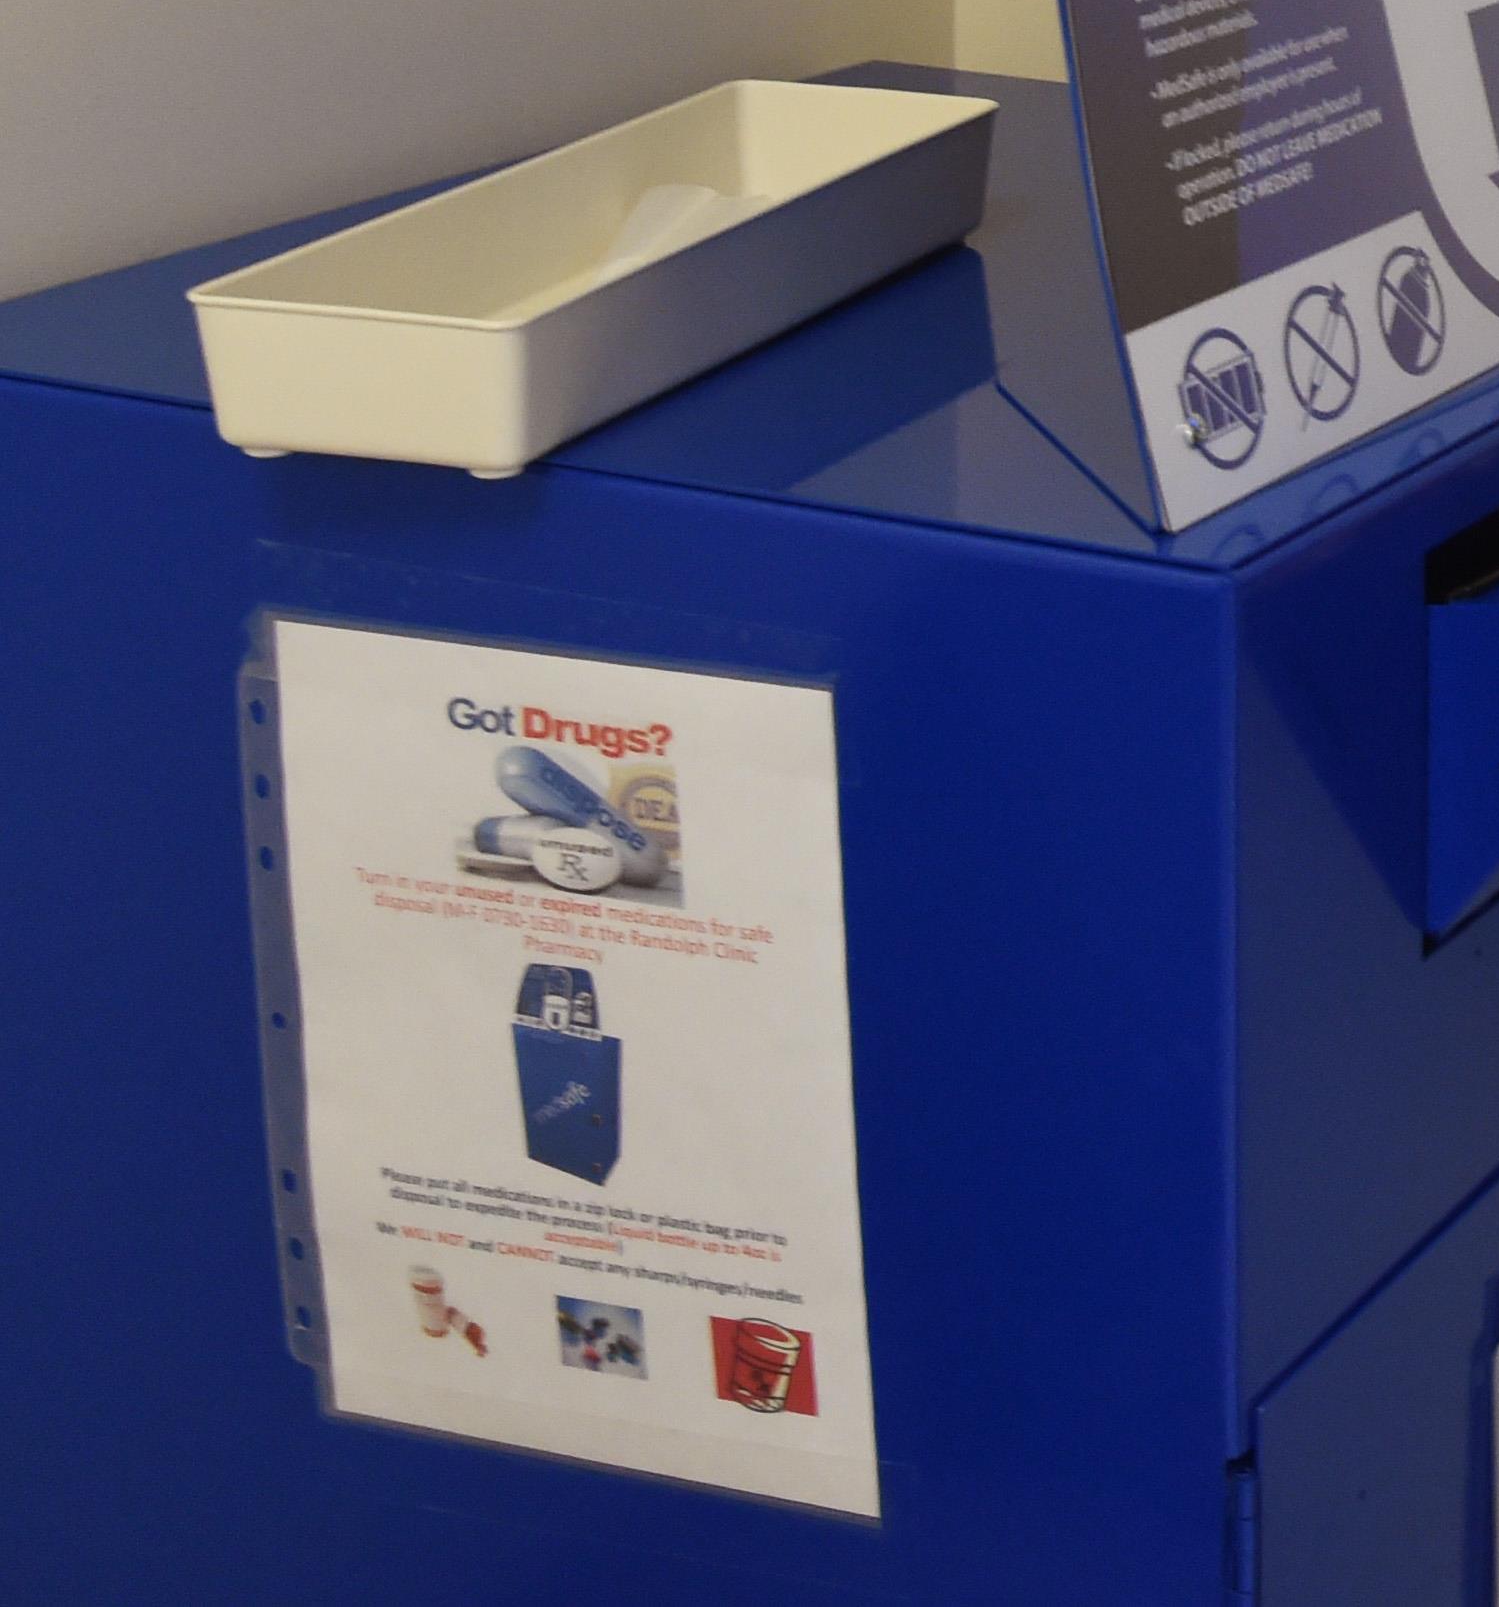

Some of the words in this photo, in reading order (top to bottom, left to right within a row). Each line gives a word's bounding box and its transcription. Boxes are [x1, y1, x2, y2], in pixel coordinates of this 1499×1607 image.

[447, 697, 516, 736] Got
[522, 705, 673, 758] Drugs?
[454, 885, 515, 905] unused
[540, 897, 602, 918] expired
